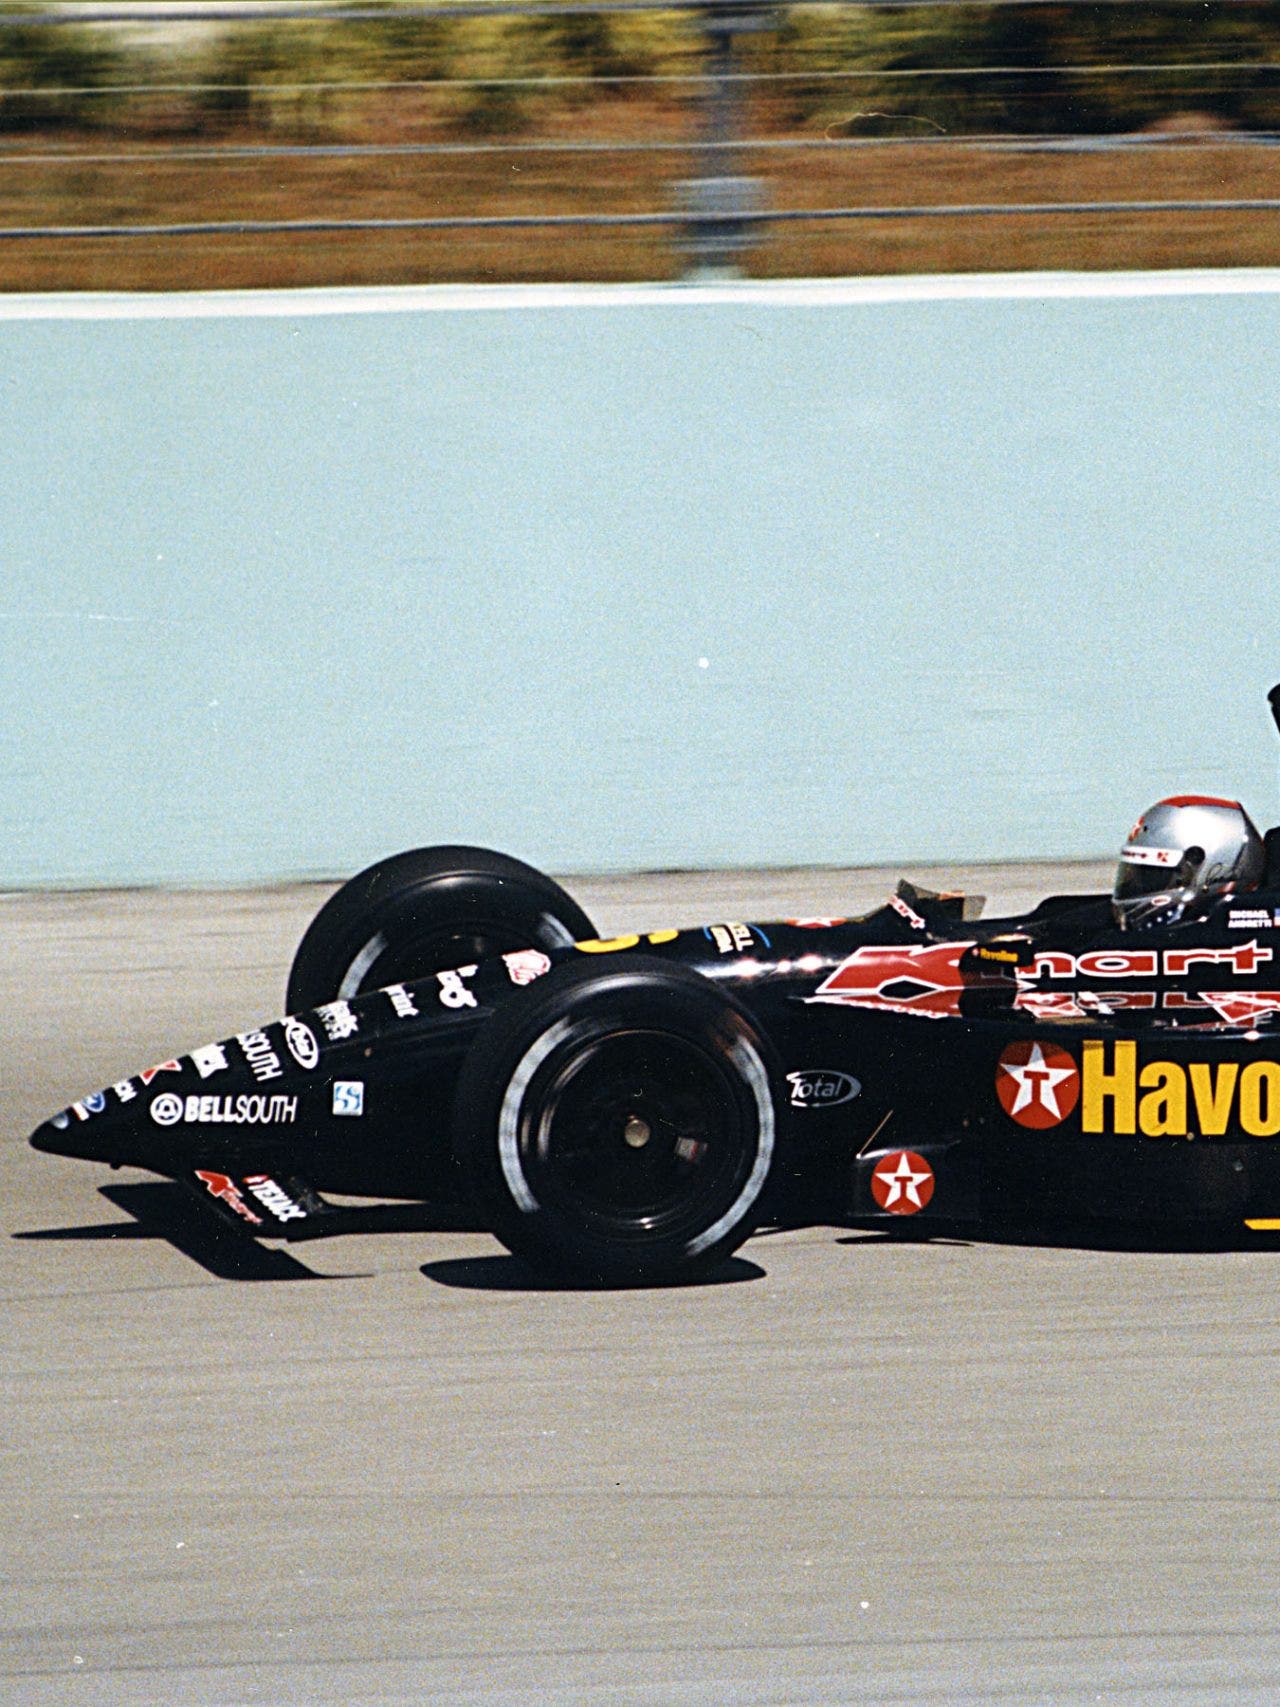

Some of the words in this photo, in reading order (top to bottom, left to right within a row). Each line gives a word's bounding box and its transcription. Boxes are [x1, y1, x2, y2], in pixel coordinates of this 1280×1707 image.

[236, 1029, 284, 1082] SOUTH
[789, 1077, 844, 1099] Total
[184, 1095, 297, 1124] BELLSOUTH
